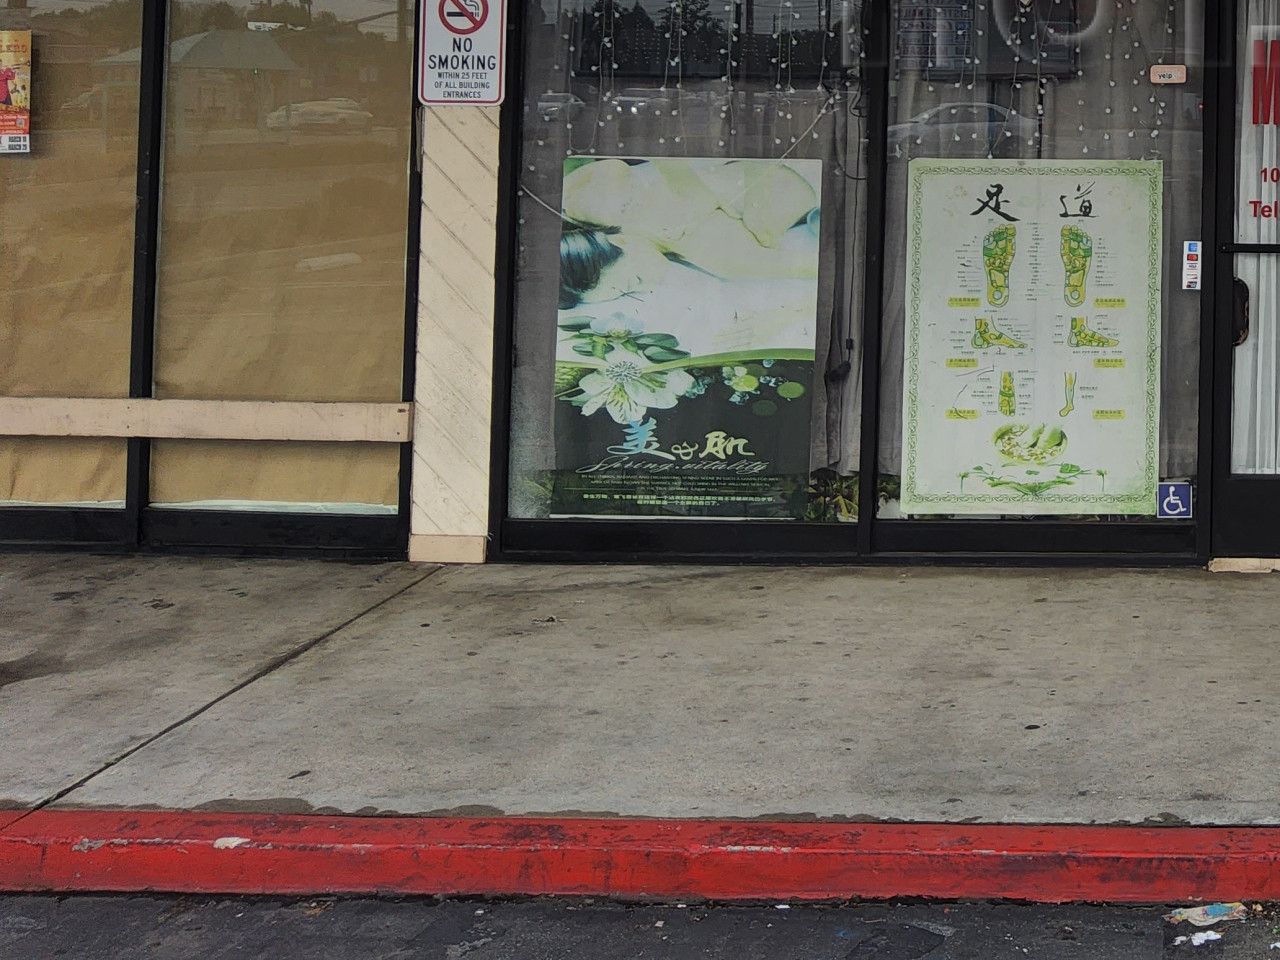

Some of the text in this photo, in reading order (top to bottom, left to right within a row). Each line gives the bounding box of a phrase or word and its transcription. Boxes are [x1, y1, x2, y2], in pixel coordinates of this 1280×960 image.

[452, 37, 473, 52] NO
[428, 54, 497, 70] SMOKING
[437, 72, 487, 80] WITHIN 25 FEET
[434, 81, 491, 90] OF ALL BUILDING
[442, 91, 482, 99] ENTRANCES
